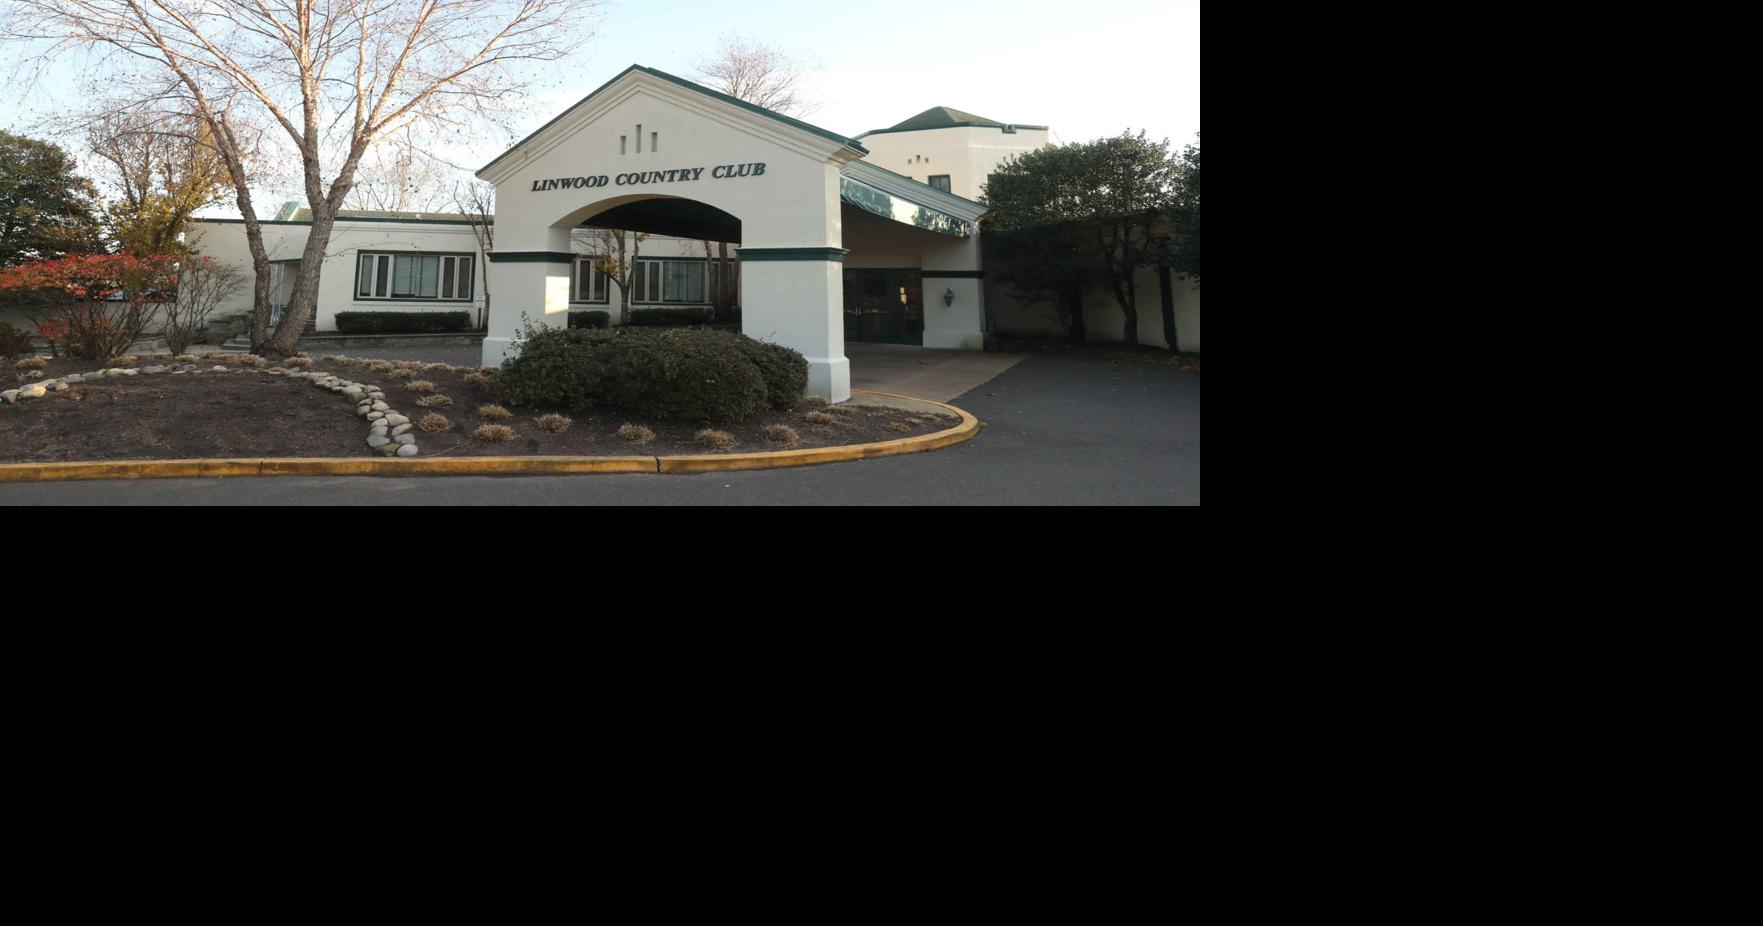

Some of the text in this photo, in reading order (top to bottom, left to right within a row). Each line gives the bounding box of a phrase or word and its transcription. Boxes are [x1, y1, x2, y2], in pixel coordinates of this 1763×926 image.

[531, 162, 766, 192] LINWOOD COUNTRY CLUB
